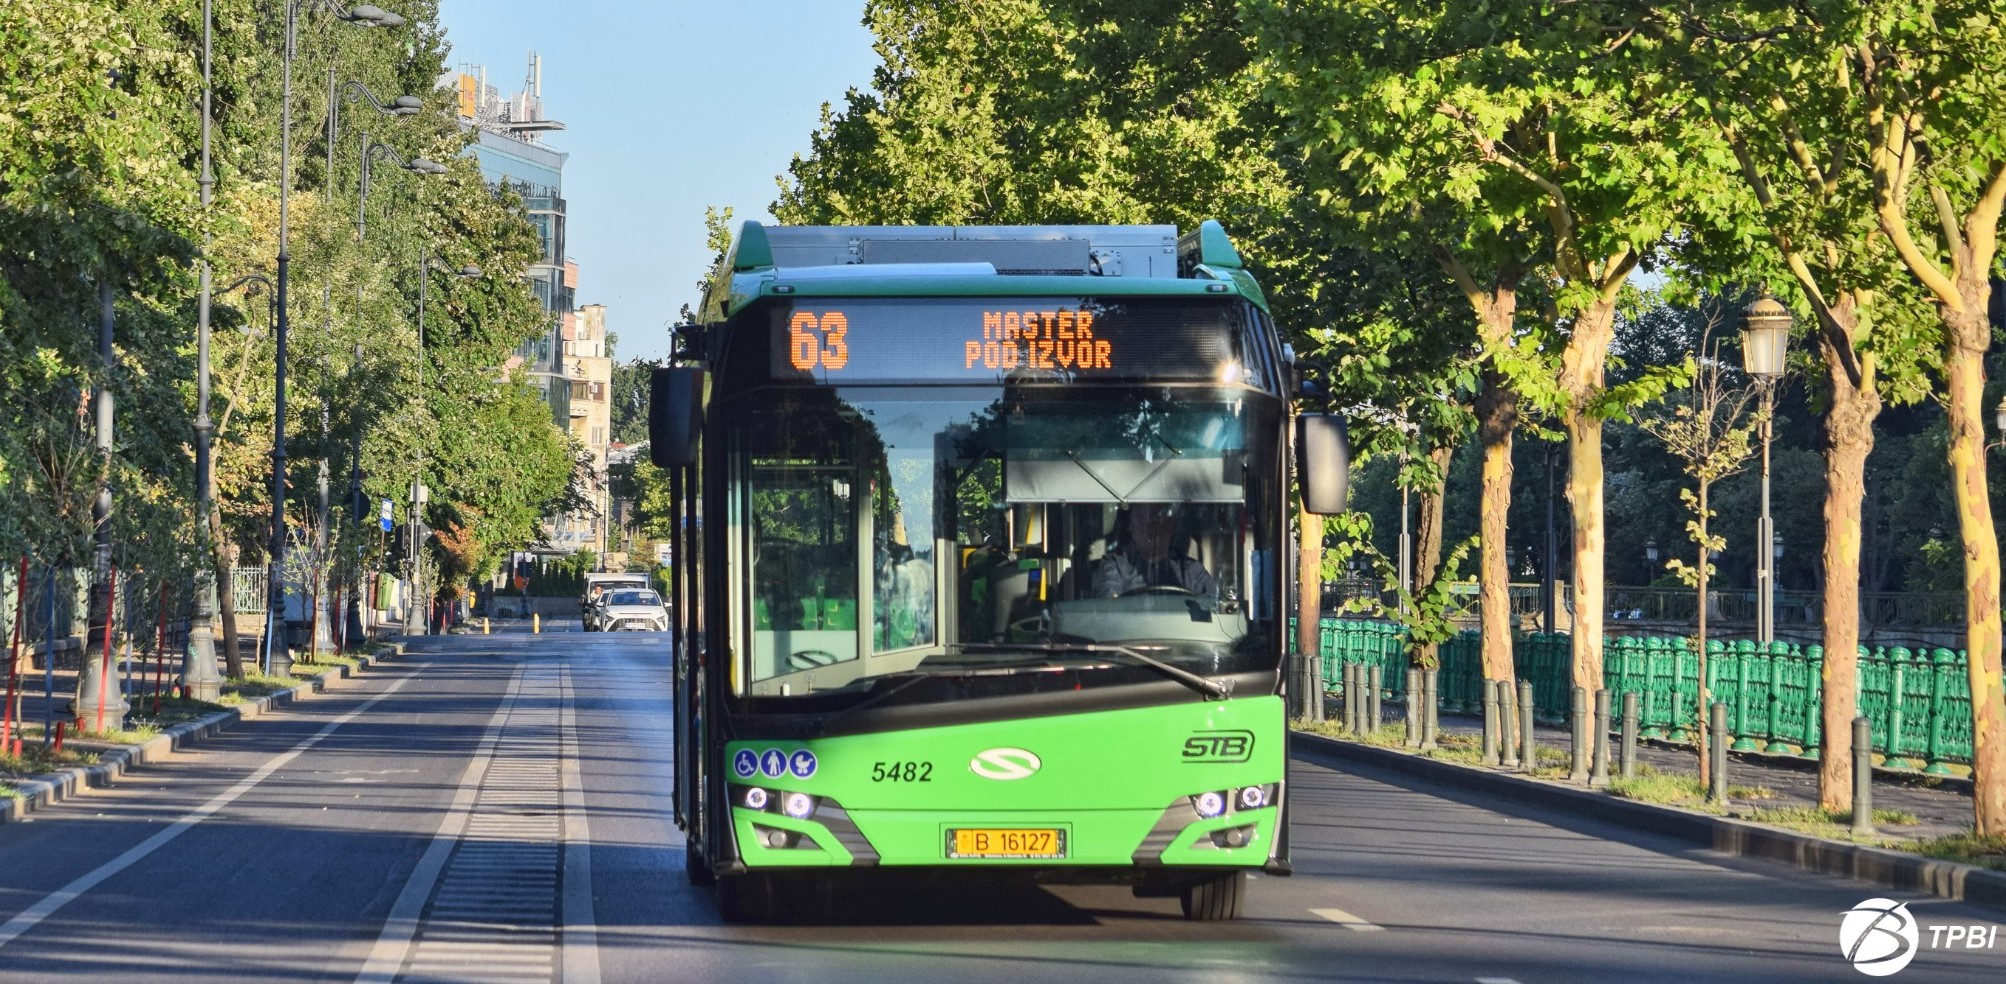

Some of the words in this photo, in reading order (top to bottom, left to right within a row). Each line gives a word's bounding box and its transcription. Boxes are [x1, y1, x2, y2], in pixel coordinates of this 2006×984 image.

[983, 311, 1093, 339] MASTER
[791, 311, 848, 369] 63
[965, 340, 1018, 369] POD
[1028, 340, 1112, 369] IZVOR
[1182, 736, 1248, 757] STB
[871, 761, 933, 782] 5482
[975, 833, 989, 851] B
[1001, 833, 1051, 851] 16127
